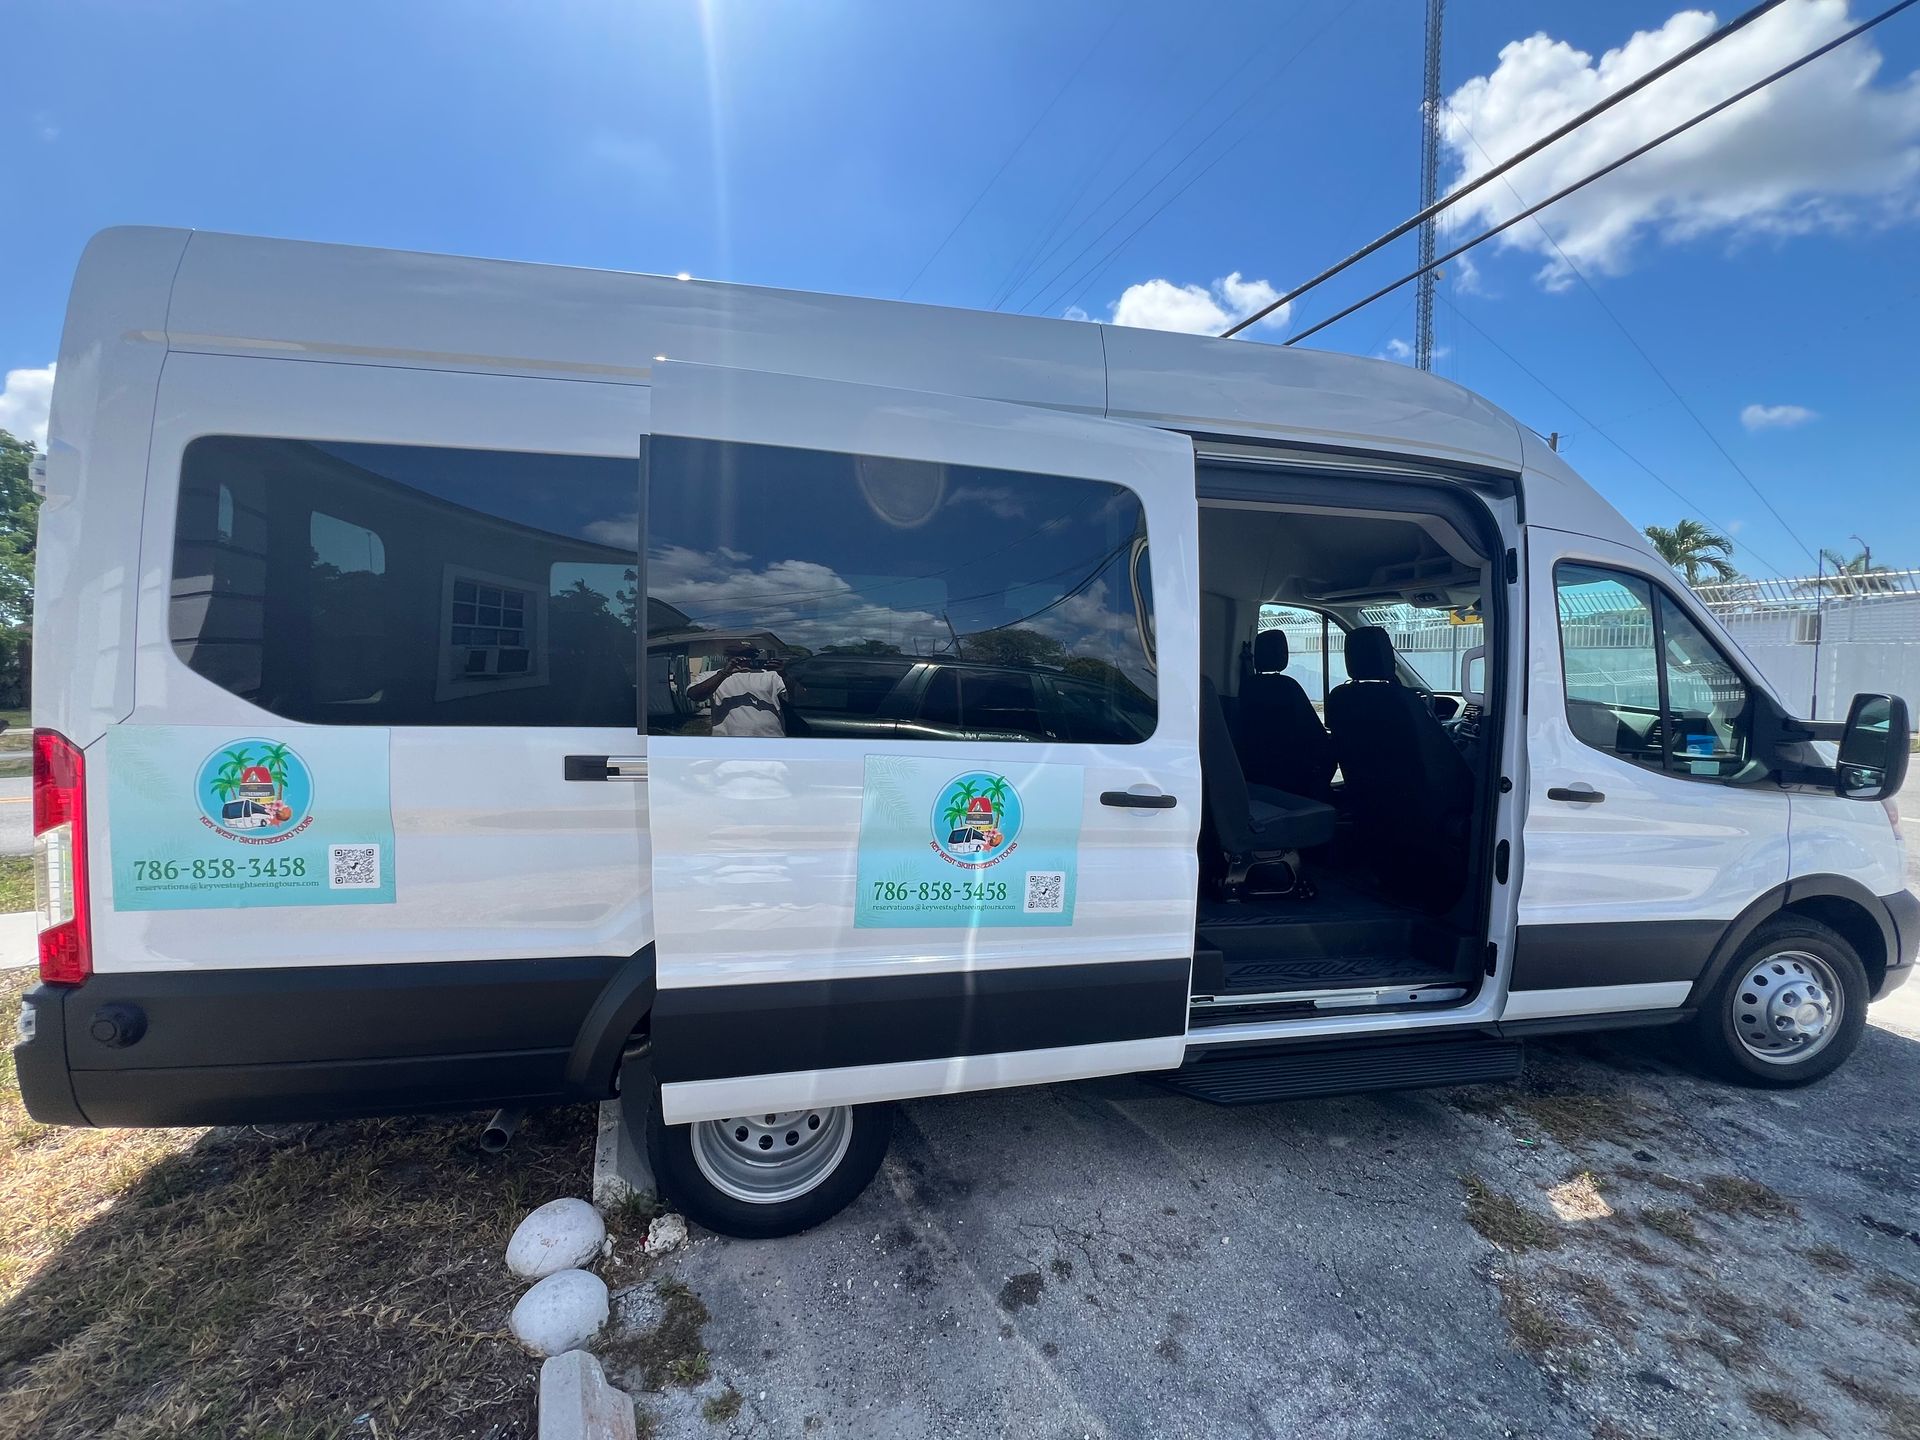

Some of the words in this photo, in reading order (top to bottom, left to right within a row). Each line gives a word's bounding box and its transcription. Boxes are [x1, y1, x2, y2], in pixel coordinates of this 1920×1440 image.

[200, 816, 216, 829] KEY
[215, 828, 237, 841] WEST
[239, 831, 294, 845] SIGHTSEEING
[292, 815, 314, 834] TOURS
[133, 856, 306, 881] 786-858-3458
[930, 840, 940, 853] KEY
[939, 851, 956, 866] WEST
[957, 858, 1000, 870] SIGHTSEEING
[999, 842, 1018, 860] TOURS
[874, 881, 1007, 901] 786-858-3458
